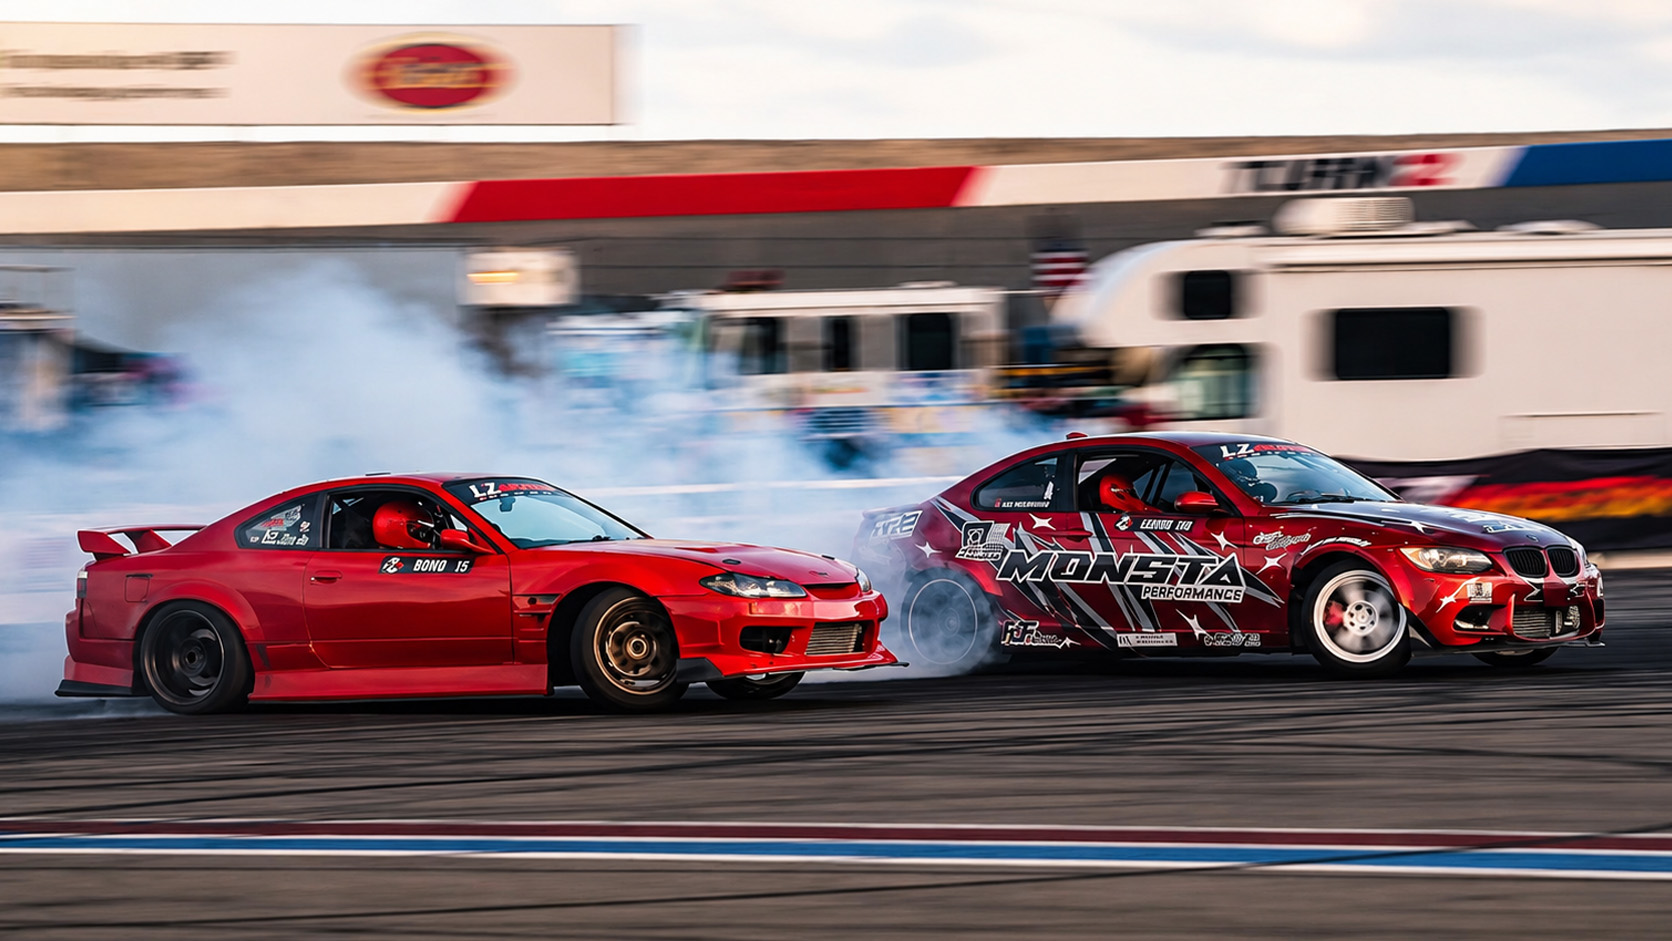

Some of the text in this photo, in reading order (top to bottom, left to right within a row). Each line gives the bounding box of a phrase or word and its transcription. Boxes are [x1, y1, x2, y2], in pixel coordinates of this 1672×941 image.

[1220, 444, 1254, 458] LZ
[469, 482, 502, 498] LZ
[413, 559, 447, 572] BONO
[996, 550, 1244, 587] MONSTA
[1142, 586, 1242, 601] PERFORMANCE
